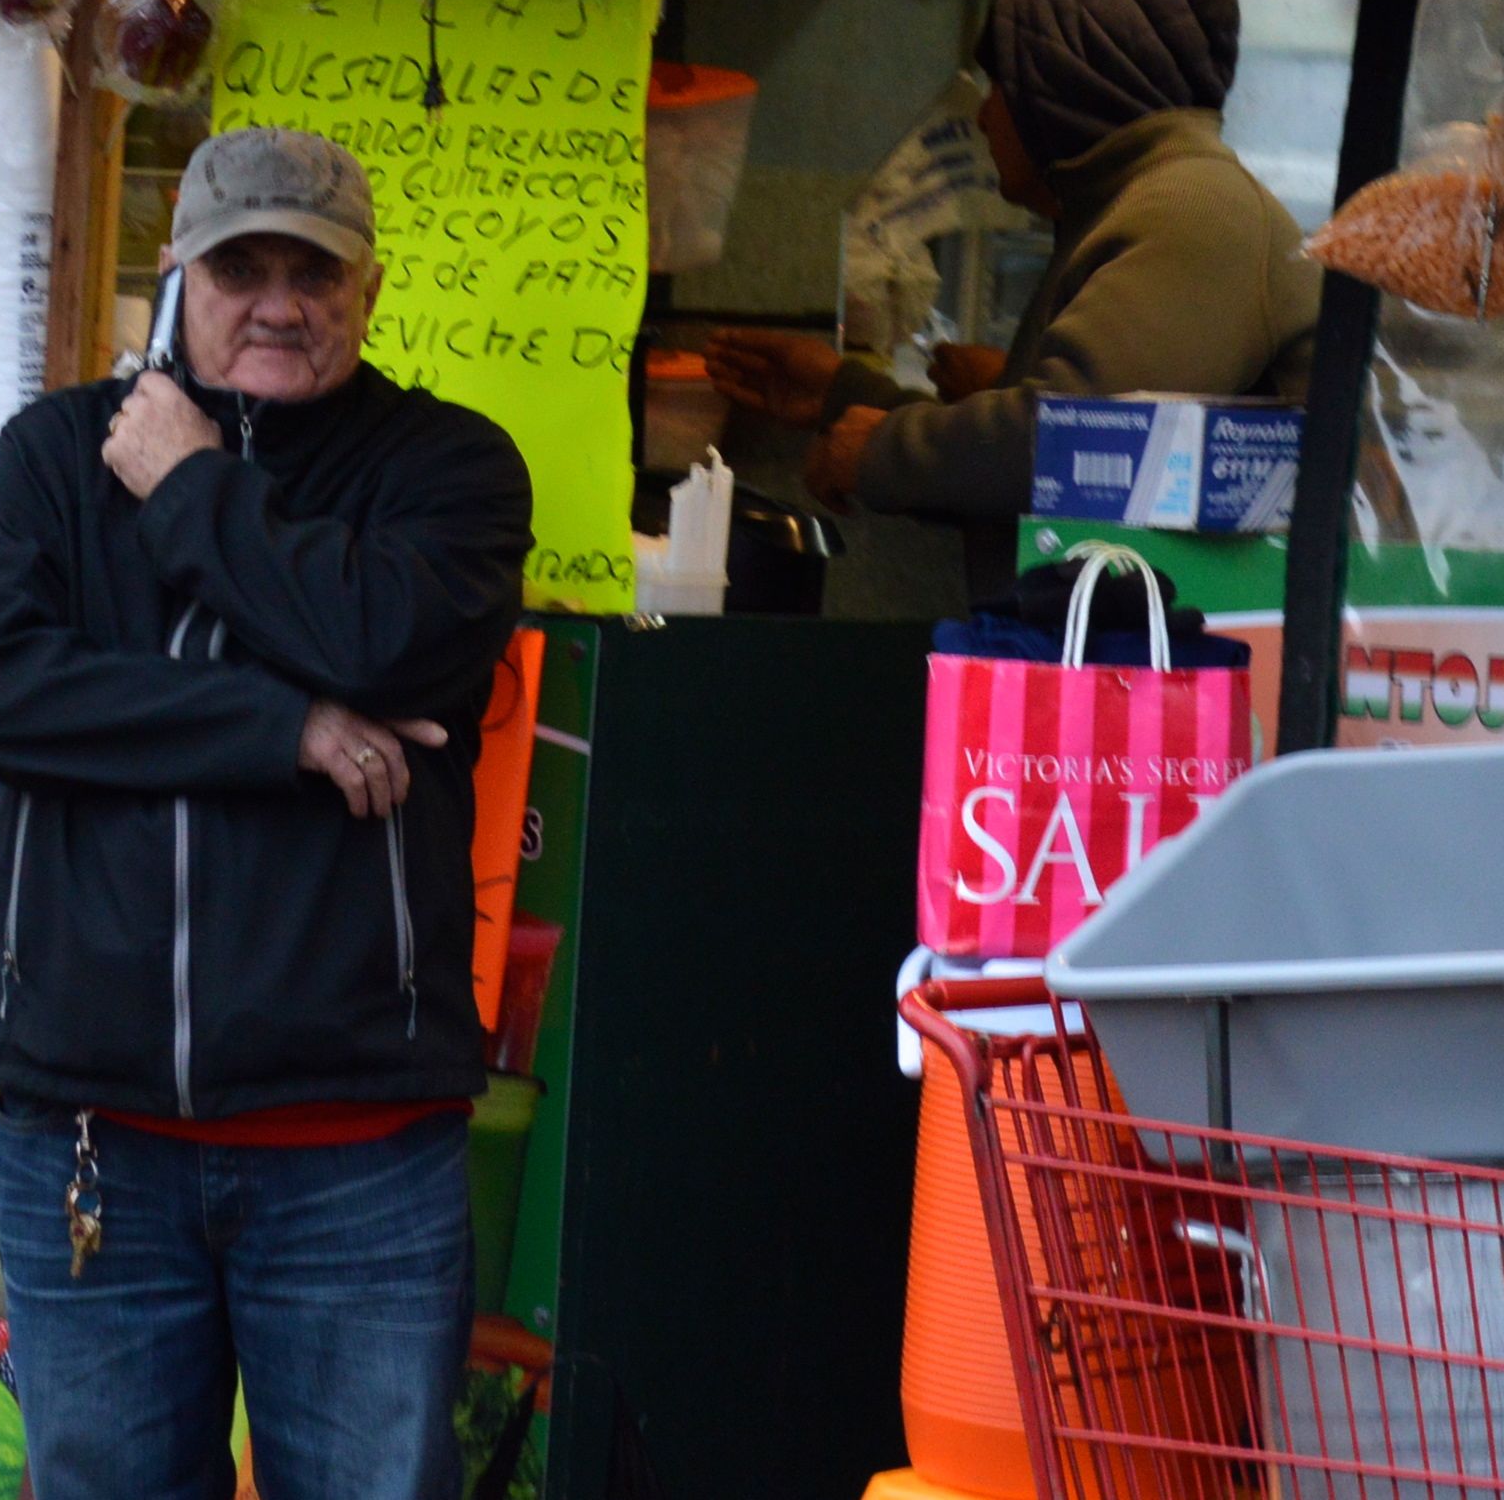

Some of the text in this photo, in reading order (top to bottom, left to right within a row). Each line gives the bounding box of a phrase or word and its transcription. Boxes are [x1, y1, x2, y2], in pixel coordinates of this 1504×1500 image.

[564, 68, 639, 113] DE
[514, 258, 638, 299] PATA
[964, 746, 1136, 786] VICTORIA'S
